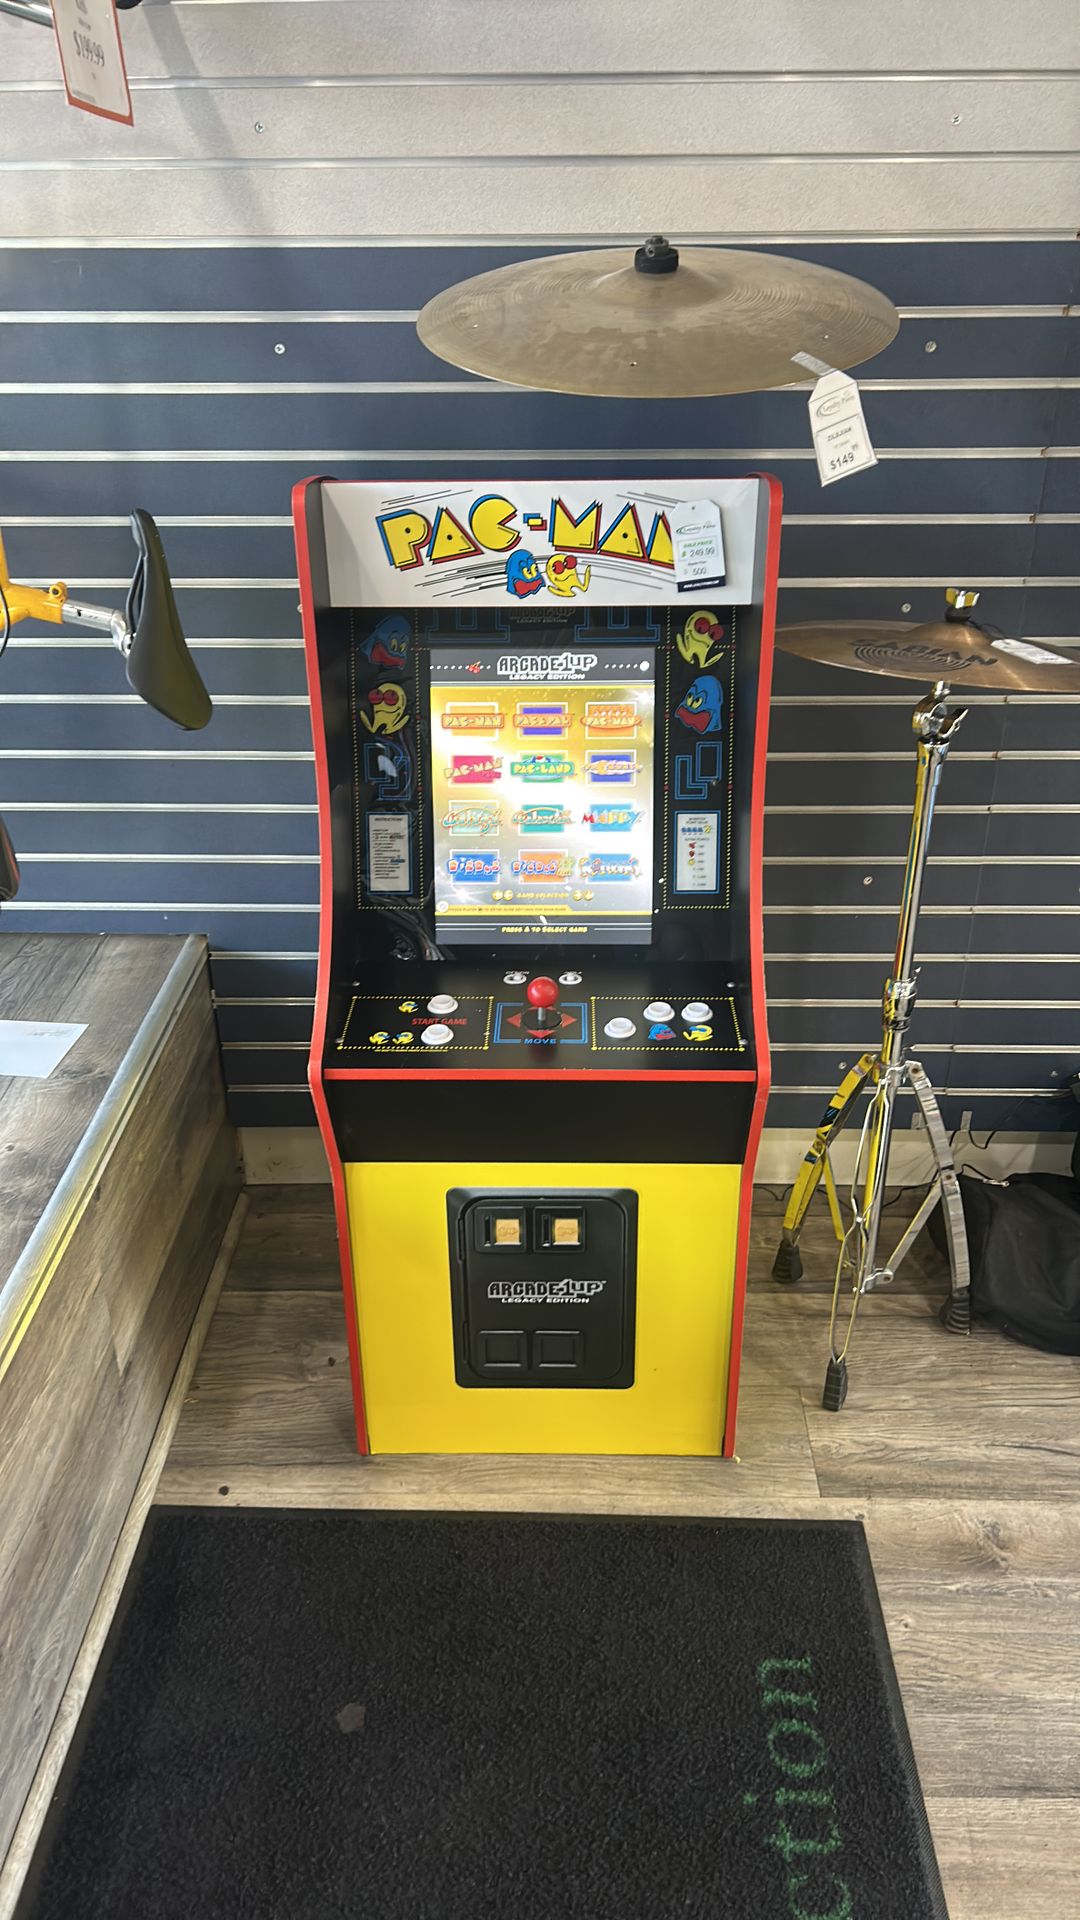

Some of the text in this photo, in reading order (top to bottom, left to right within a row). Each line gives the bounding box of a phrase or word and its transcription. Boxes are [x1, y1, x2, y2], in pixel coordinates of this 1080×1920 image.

[829, 451, 855, 470] $149
[689, 545, 716, 558] 249.99
[850, 638, 998, 666] SABIAN
[547, 673, 586, 681] EDITION
[443, 714, 502, 728] PAC-MAN
